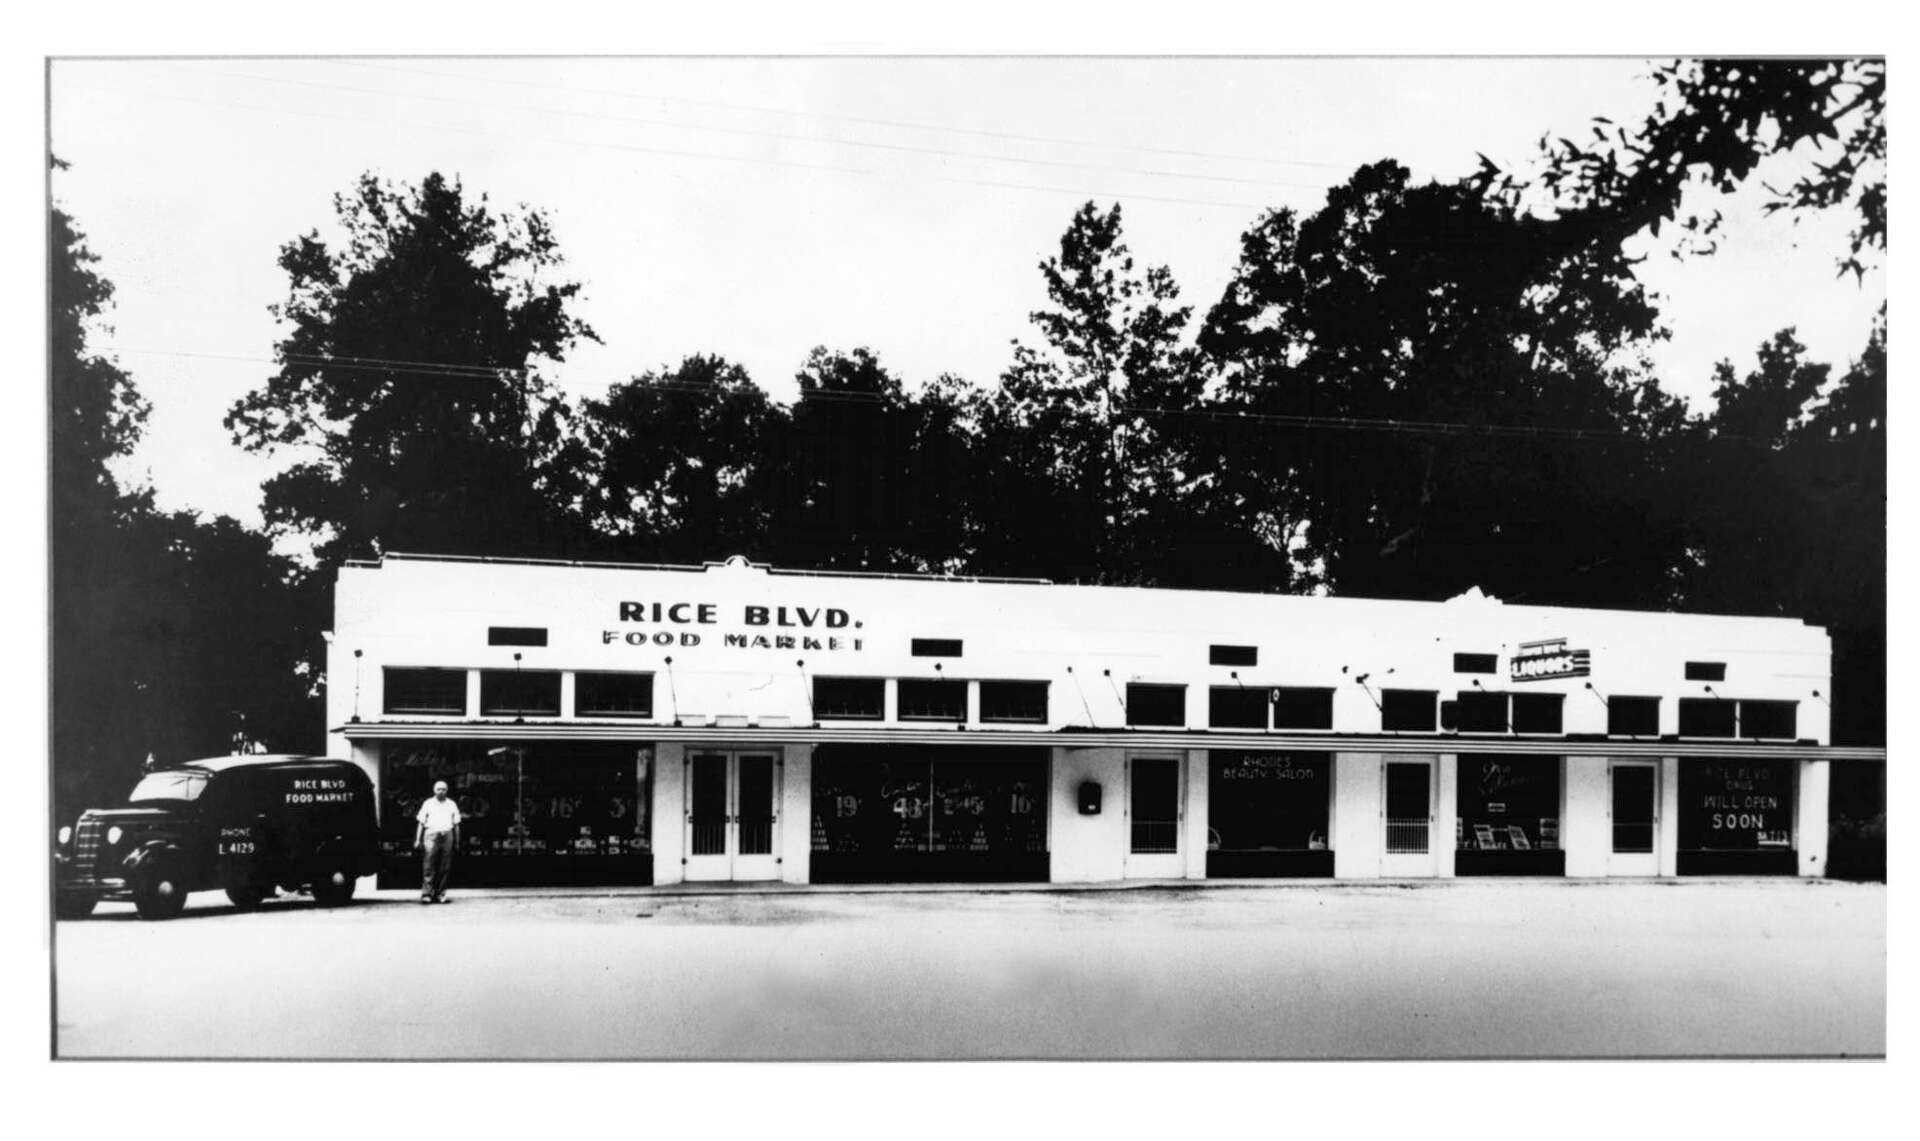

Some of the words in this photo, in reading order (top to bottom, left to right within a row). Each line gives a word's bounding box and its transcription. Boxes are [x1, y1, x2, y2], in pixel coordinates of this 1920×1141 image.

[619, 600, 718, 624] RICE
[744, 605, 864, 629] BLVD.
[602, 630, 702, 647] FOOD
[724, 633, 864, 651] MARKET
[1511, 653, 1574, 677] LIQUORS
[1241, 755, 1293, 768] RHODES
[1223, 768, 1268, 781] BEAUTY
[1275, 768, 1315, 781] SALON
[293, 779, 317, 791] RICE
[320, 779, 347, 791] BLVD
[285, 792, 314, 804] FOOD
[315, 791, 354, 803] MARKET
[1703, 794, 1740, 810] WILL
[1744, 795, 1779, 810] OPEN
[1711, 813, 1765, 830] SOON
[220, 827, 251, 838] PHONE
[218, 843, 227, 855] L
[229, 842, 256, 855] 4129
